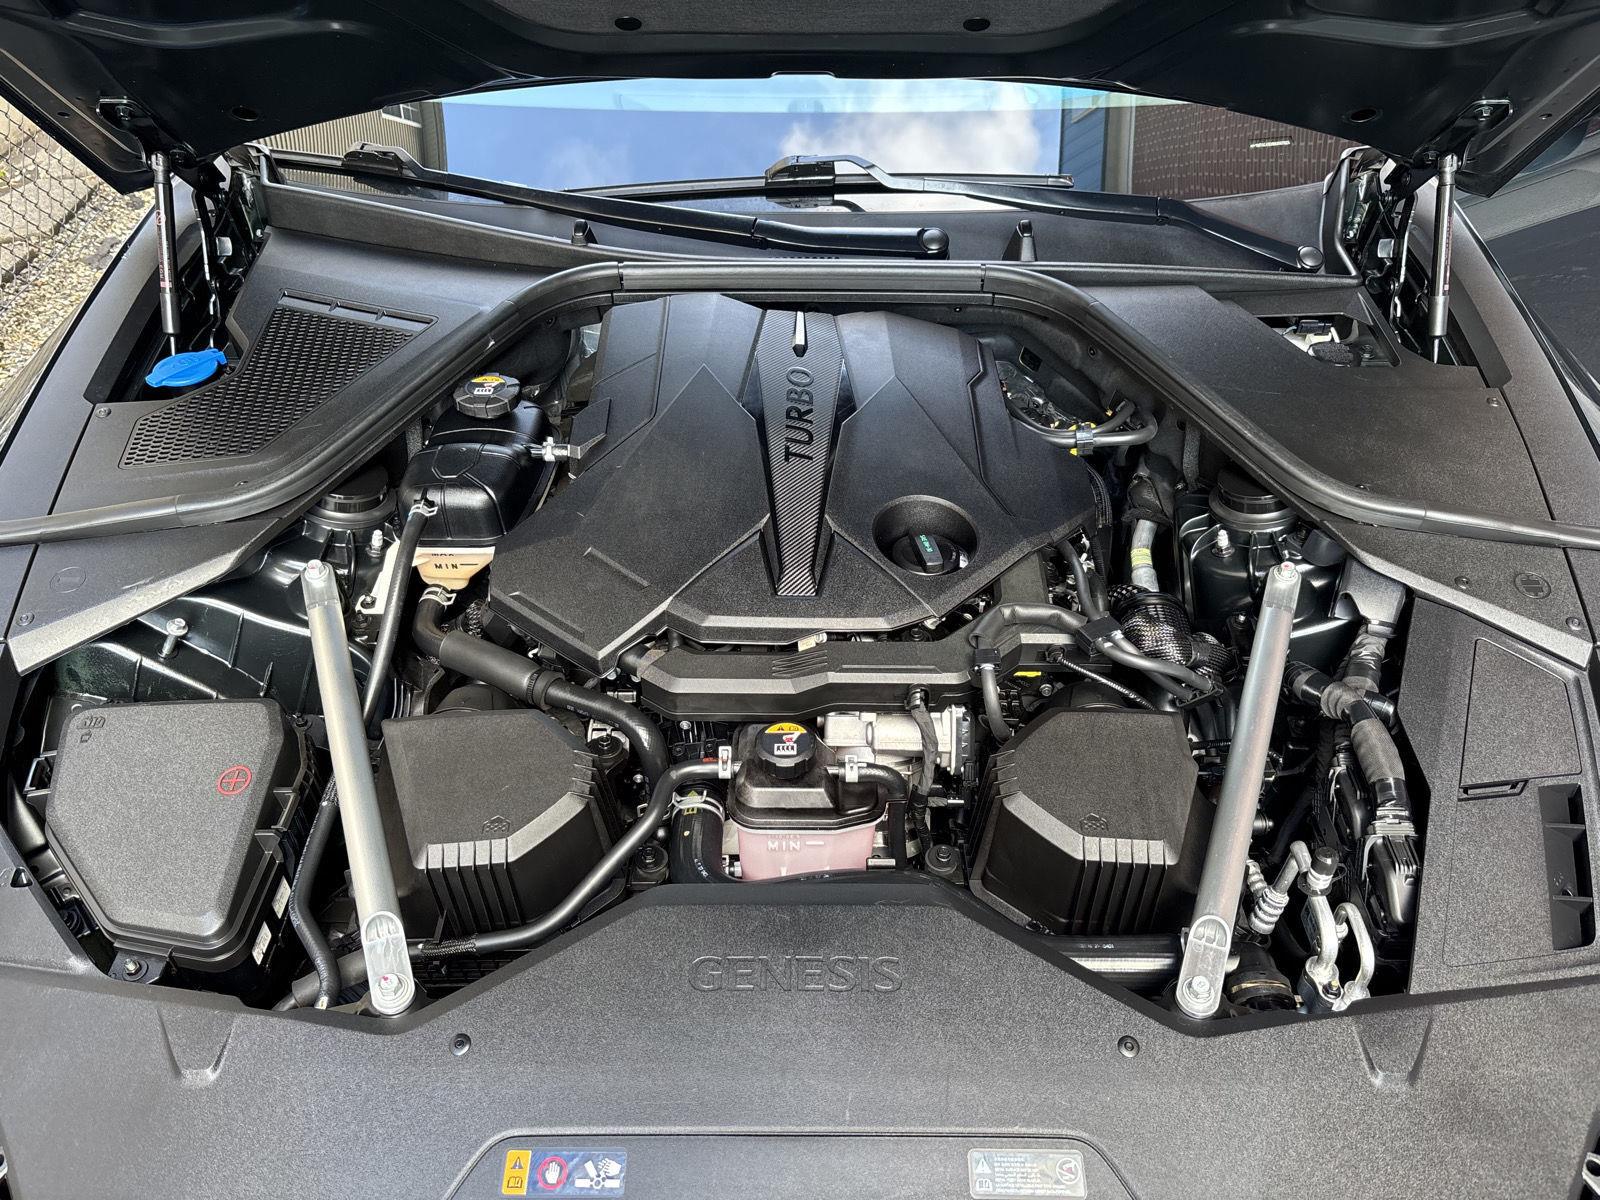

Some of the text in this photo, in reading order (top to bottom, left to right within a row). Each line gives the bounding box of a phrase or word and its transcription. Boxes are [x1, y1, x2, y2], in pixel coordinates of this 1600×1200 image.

[784, 366, 814, 463] TURBO
[767, 840, 800, 851] MIN
[688, 955, 903, 992] GENESIS
